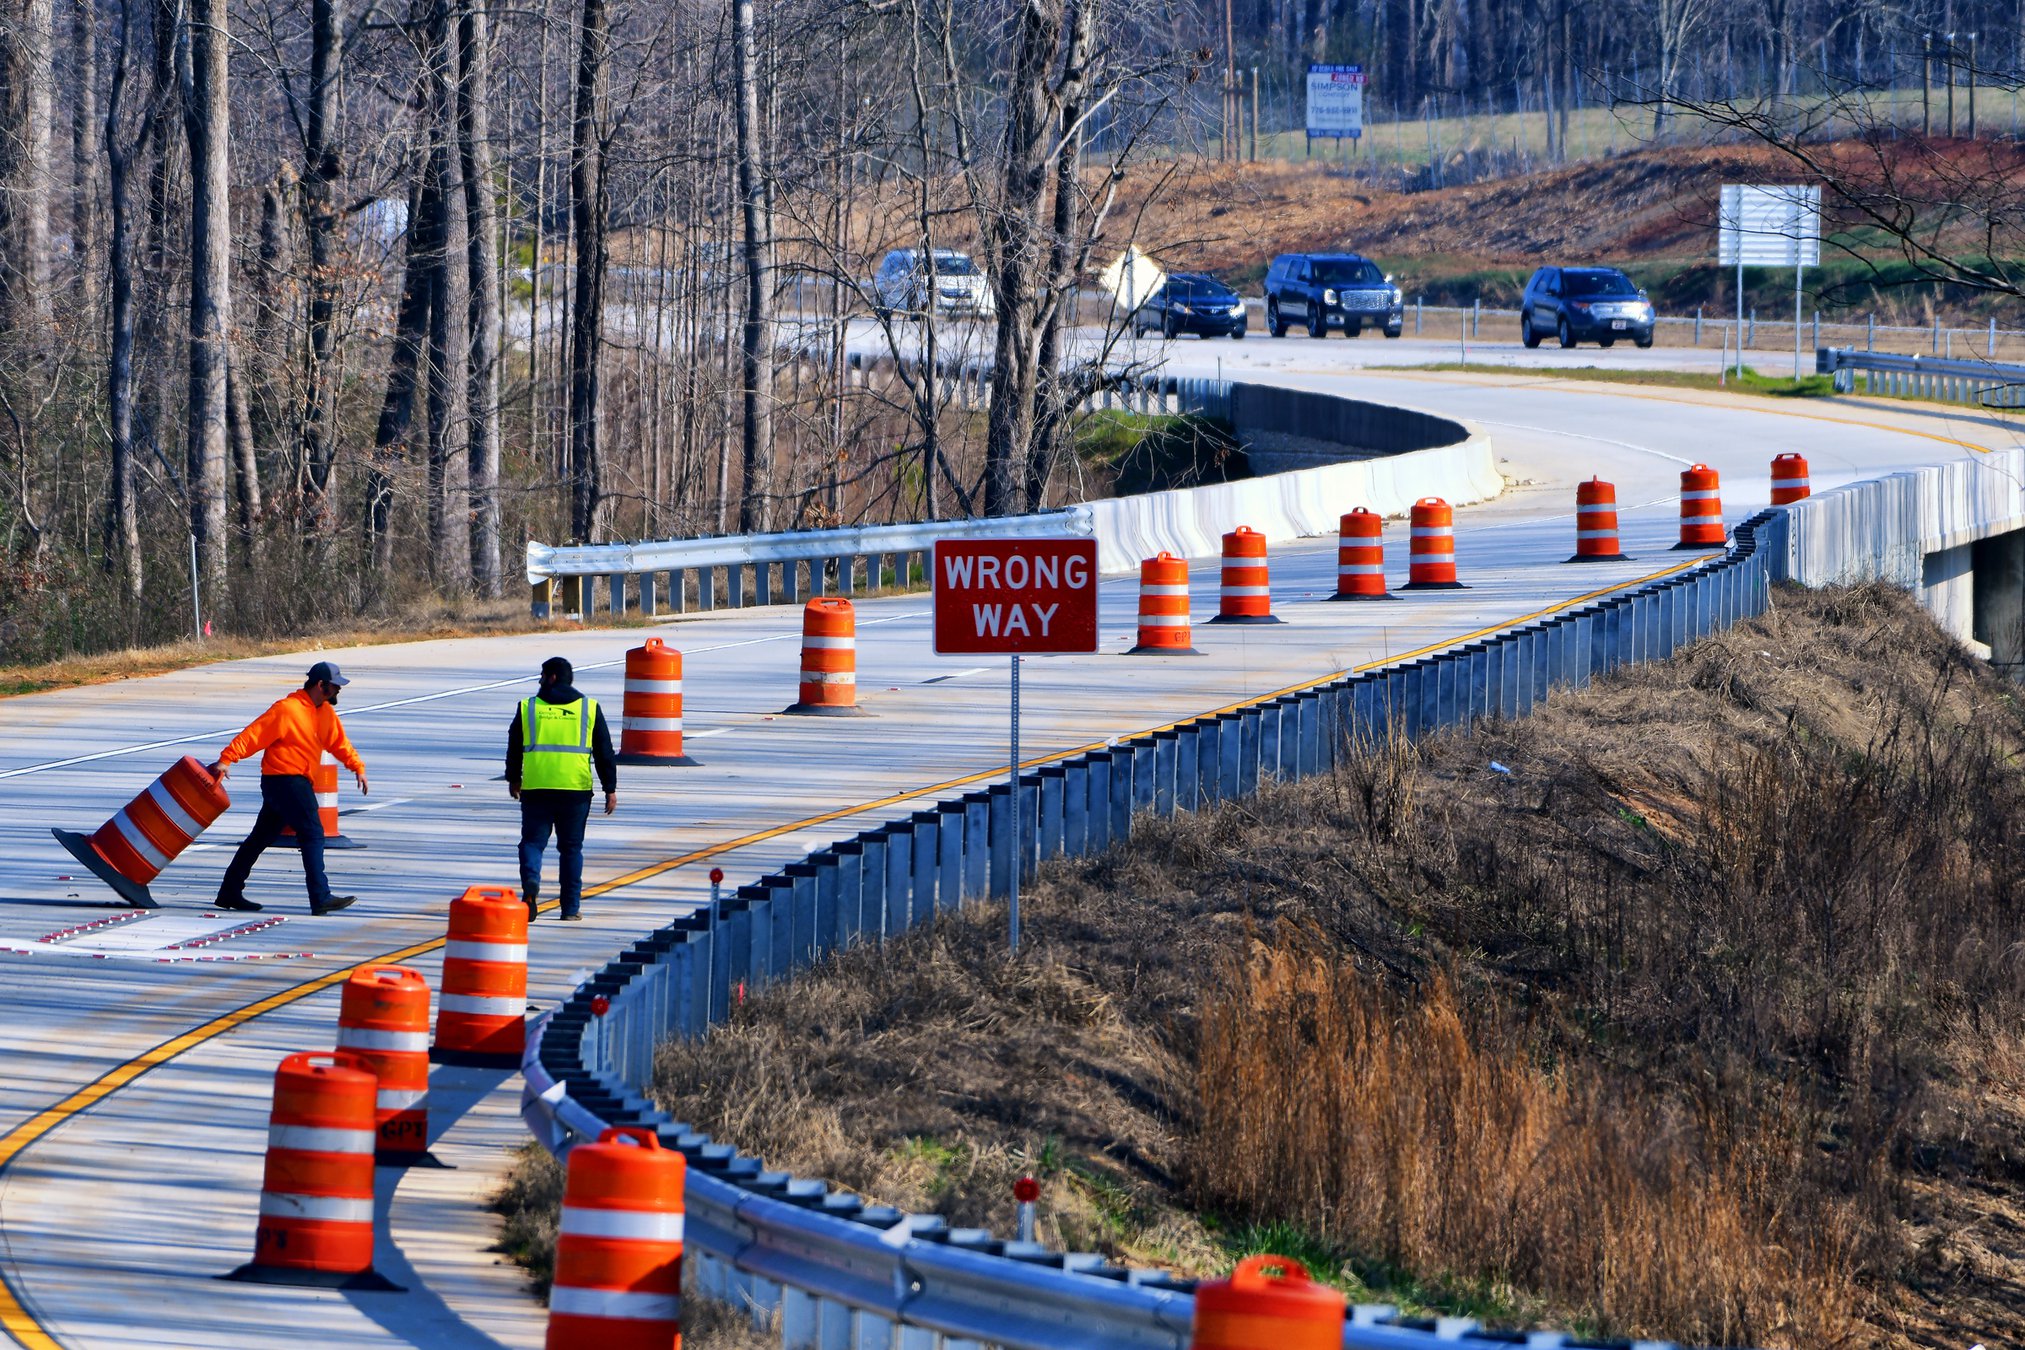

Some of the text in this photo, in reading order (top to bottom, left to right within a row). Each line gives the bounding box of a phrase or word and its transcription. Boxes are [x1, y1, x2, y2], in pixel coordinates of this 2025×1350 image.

[1311, 82, 1358, 91] SIMPSON
[944, 555, 1088, 590] WRONG
[972, 603, 1060, 637] WAY
